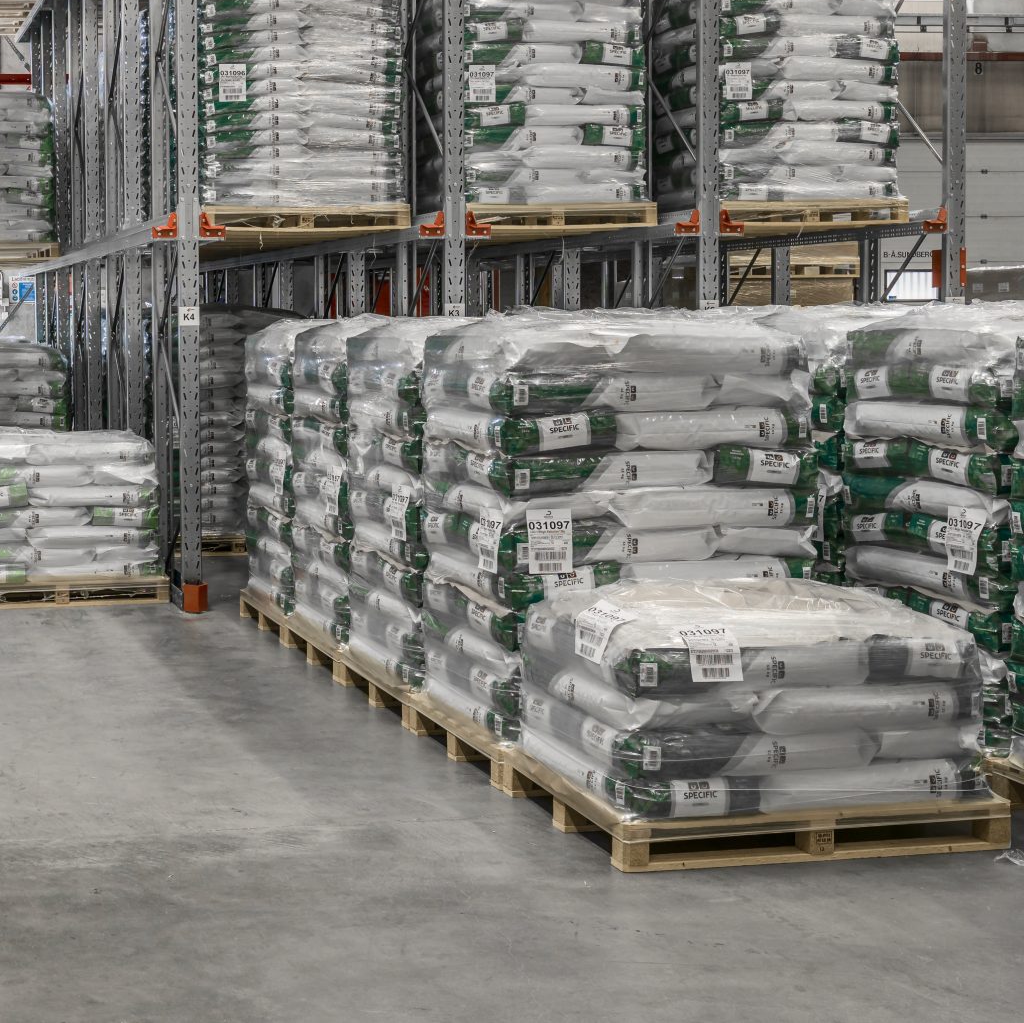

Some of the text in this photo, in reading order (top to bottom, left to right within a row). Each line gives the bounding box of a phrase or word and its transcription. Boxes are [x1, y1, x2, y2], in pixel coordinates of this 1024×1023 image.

[975, 62, 983, 75] 8
[183, 313, 195, 322] K4
[448, 309, 460, 317] K3
[936, 376, 959, 385] SPECIFIC
[549, 424, 580, 434] SPECIFIC
[760, 460, 790, 468] SPECIFIC
[936, 457, 960, 468] SPECIFIC
[528, 521, 570, 530] 031097
[948, 518, 982, 530] 031097
[554, 578, 584, 588] SPECIFIC
[588, 607, 626, 622] 031097
[936, 608, 961, 622] SPECIFIC
[679, 628, 725, 636] 031097
[920, 651, 952, 660] SPECIFIC
[684, 790, 718, 800] SPECIFIC
